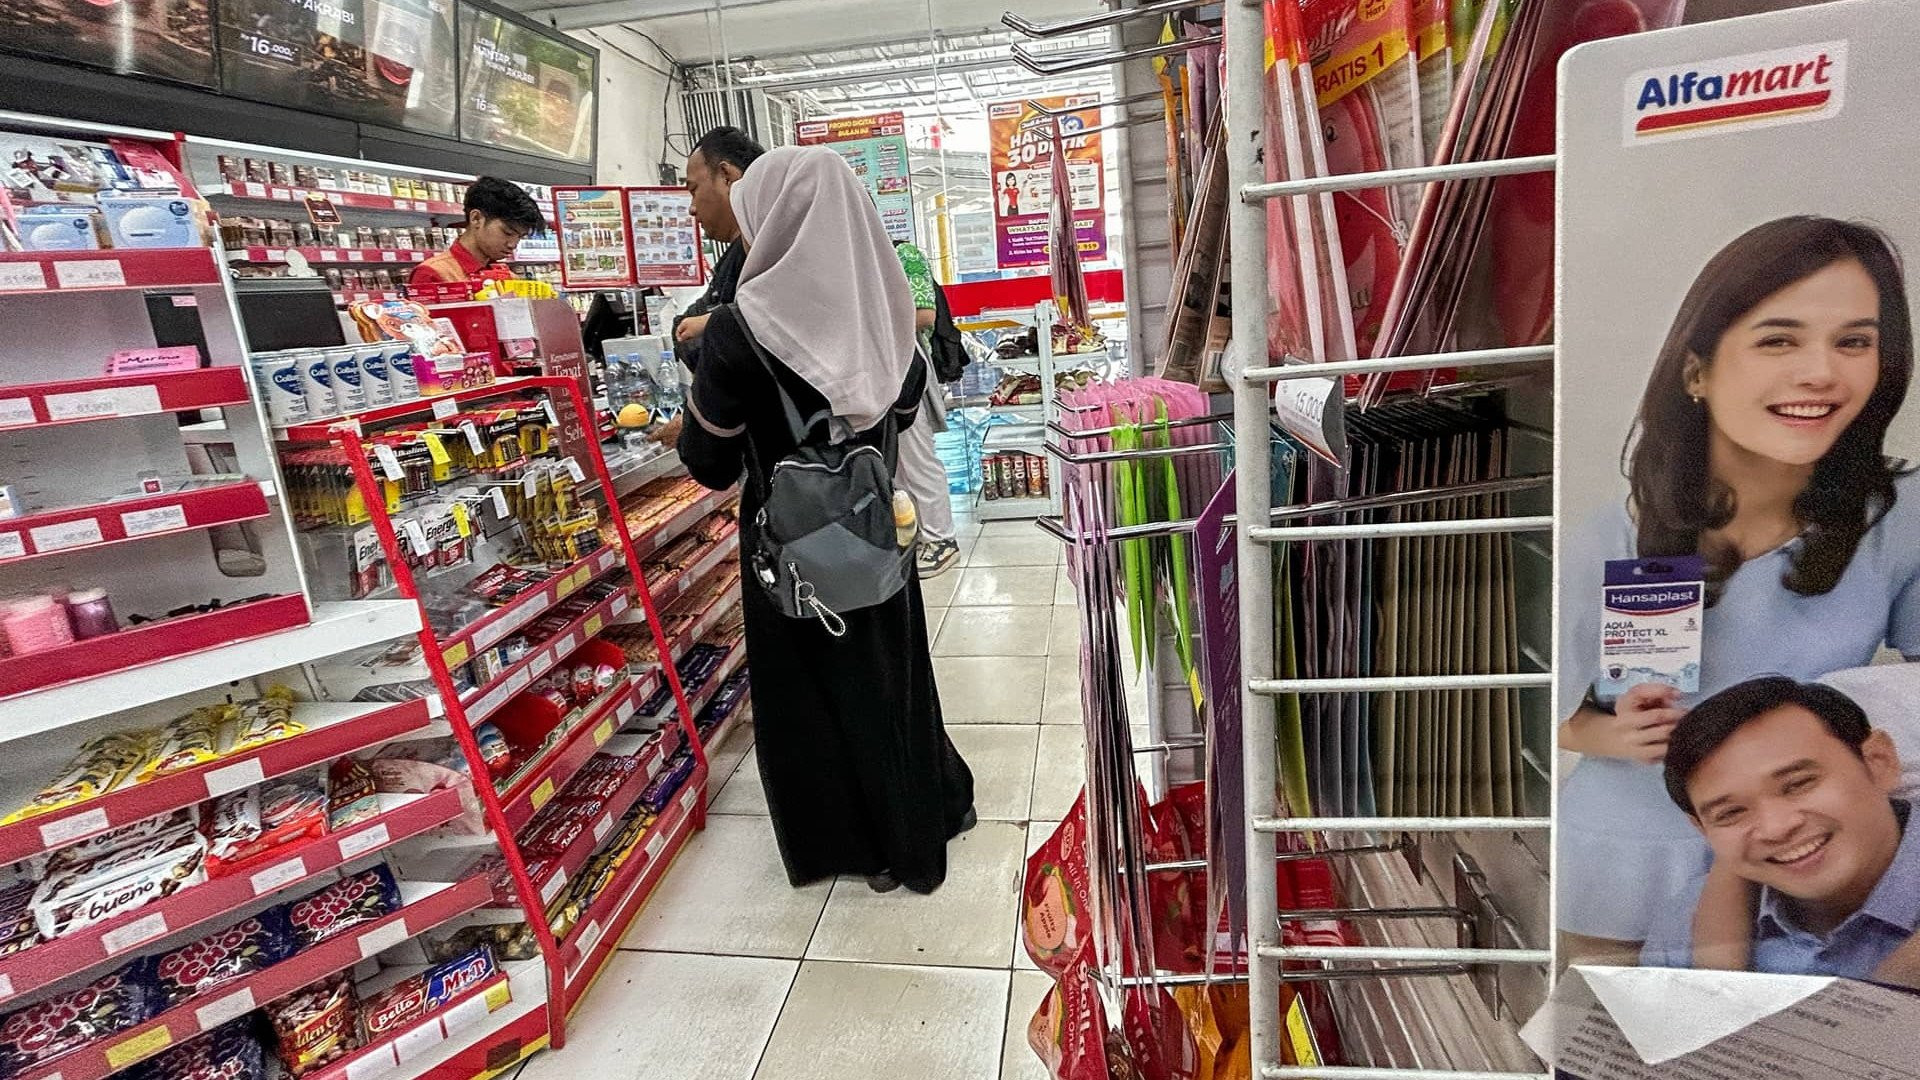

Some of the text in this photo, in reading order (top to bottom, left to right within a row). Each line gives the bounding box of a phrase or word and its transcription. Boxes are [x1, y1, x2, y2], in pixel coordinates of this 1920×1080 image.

[303, 0, 355, 25] AKRAB!
[1314, 41, 1384, 96] RATIS 1
[1636, 53, 1833, 111] Alfamart
[1007, 143, 1036, 168] 30
[1611, 590, 1694, 604] Hansaplast
[1604, 621, 1634, 629] AQUA
[1604, 629, 1668, 637] PROTECT XL
[1688, 618, 1695, 627] 5
[1067, 861, 1078, 877] All
[89, 881, 155, 920] bueno
[377, 999, 417, 1028] Bella
[1067, 1020, 1077, 1049] One
